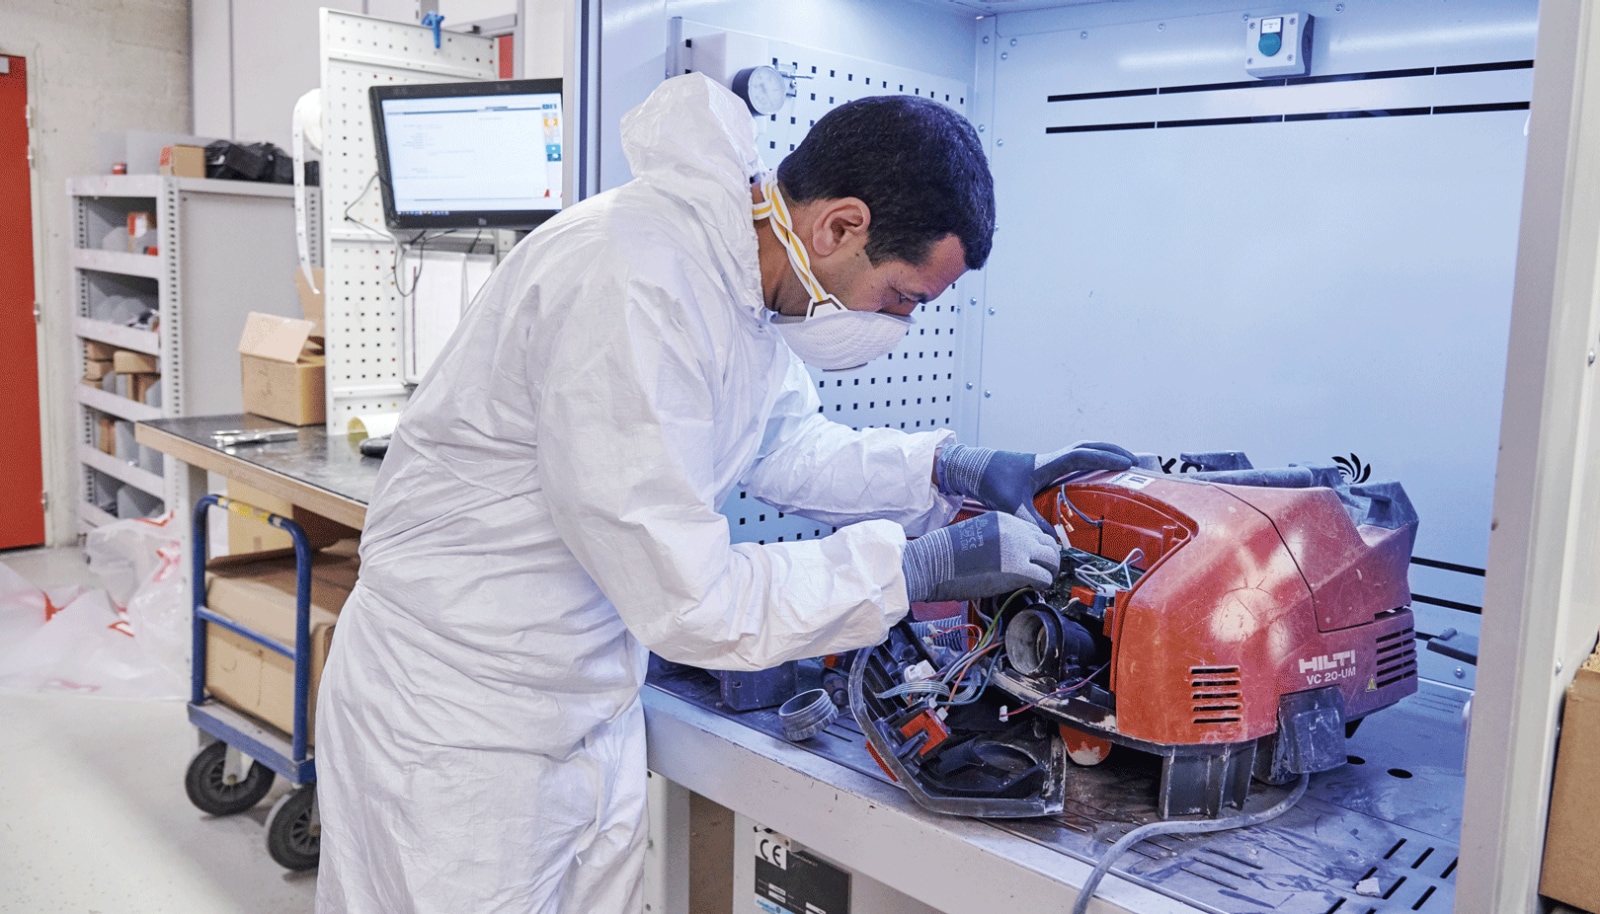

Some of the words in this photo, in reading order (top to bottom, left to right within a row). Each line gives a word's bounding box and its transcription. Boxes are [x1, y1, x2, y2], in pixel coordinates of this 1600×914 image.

[1299, 650, 1355, 673] HILTI
[1306, 674, 1322, 685] VC
[1325, 667, 1356, 681] 20-UM
[760, 839, 781, 866] CE
